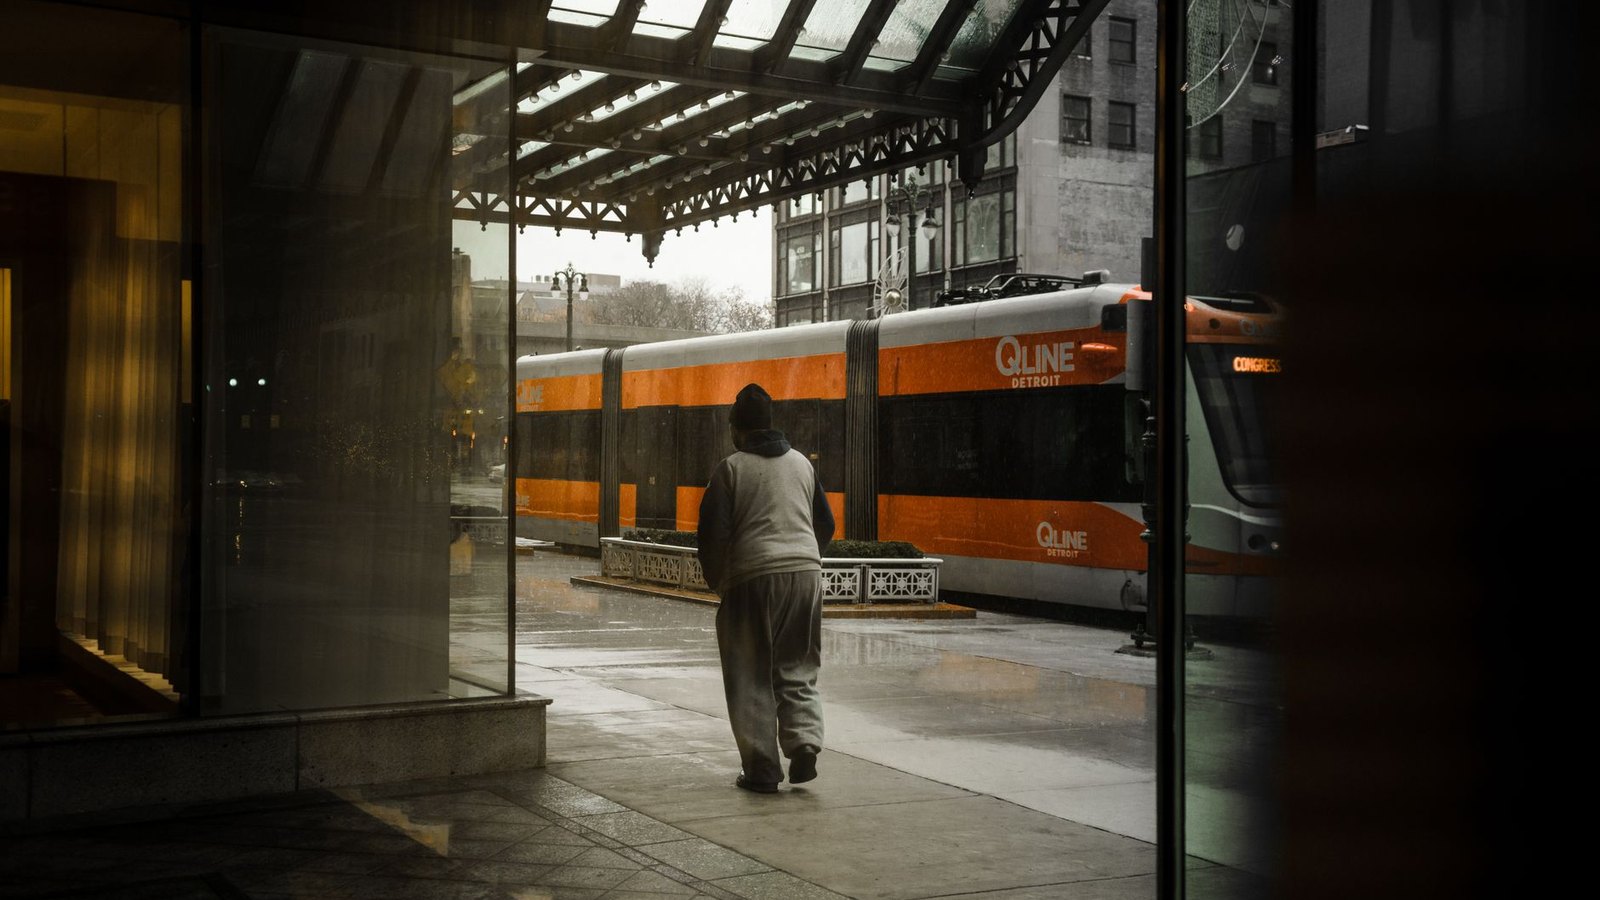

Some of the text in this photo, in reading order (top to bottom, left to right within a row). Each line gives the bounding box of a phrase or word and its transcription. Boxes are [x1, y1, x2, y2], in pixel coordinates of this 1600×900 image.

[995, 335, 1075, 376] QLINE
[1012, 375, 1061, 388] DETROIT
[1036, 521, 1087, 550] QLINE
[1047, 549, 1079, 558] DETROIT
